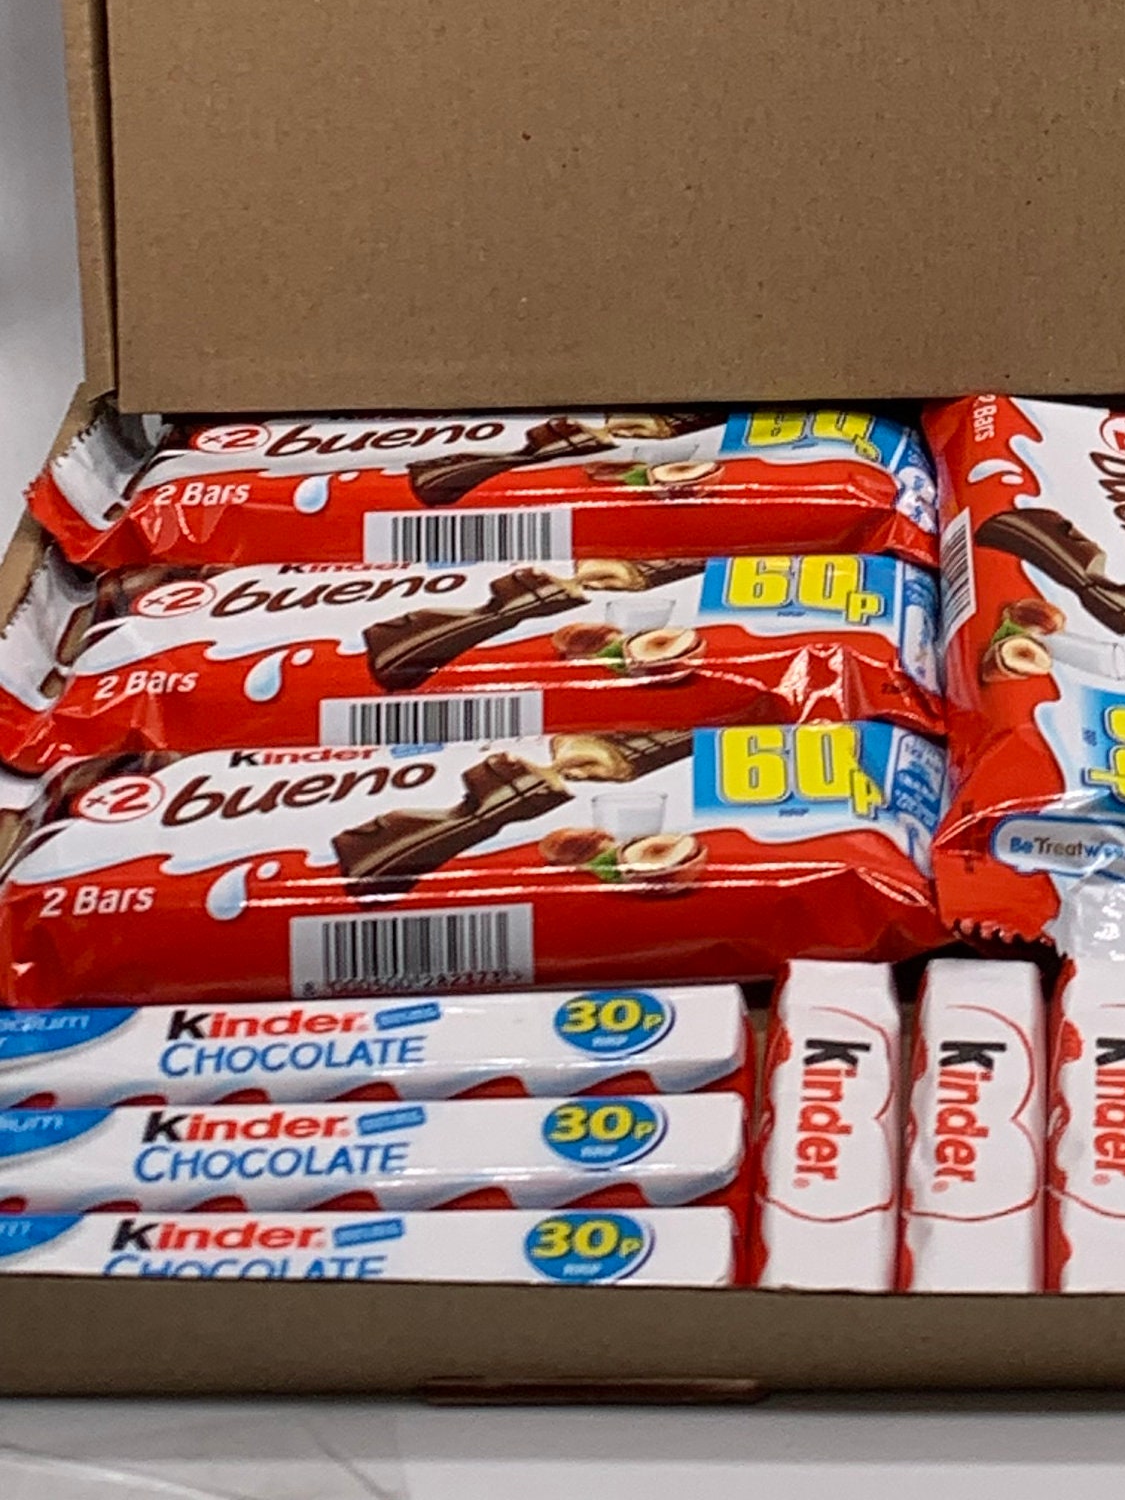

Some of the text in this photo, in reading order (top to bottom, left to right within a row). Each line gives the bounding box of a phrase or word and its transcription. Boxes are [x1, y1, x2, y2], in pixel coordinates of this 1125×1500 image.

[265, 421, 505, 457] bueno
[153, 482, 250, 505] 2 Bars
[210, 573, 468, 618] bueno
[94, 669, 198, 699] 2 Bars
[229, 746, 379, 768] Kinder
[161, 762, 436, 827] bueno
[39, 885, 156, 918] 2 Bars
[167, 1010, 367, 1040] Kinder
[159, 1035, 428, 1077] CHOCOLATE
[142, 1110, 347, 1143] Kinder
[795, 1038, 871, 1181] Kinder
[934, 1041, 1007, 1183] Kinder
[134, 1142, 411, 1183] CHOCOLATE
[111, 1219, 324, 1252] Kinder
